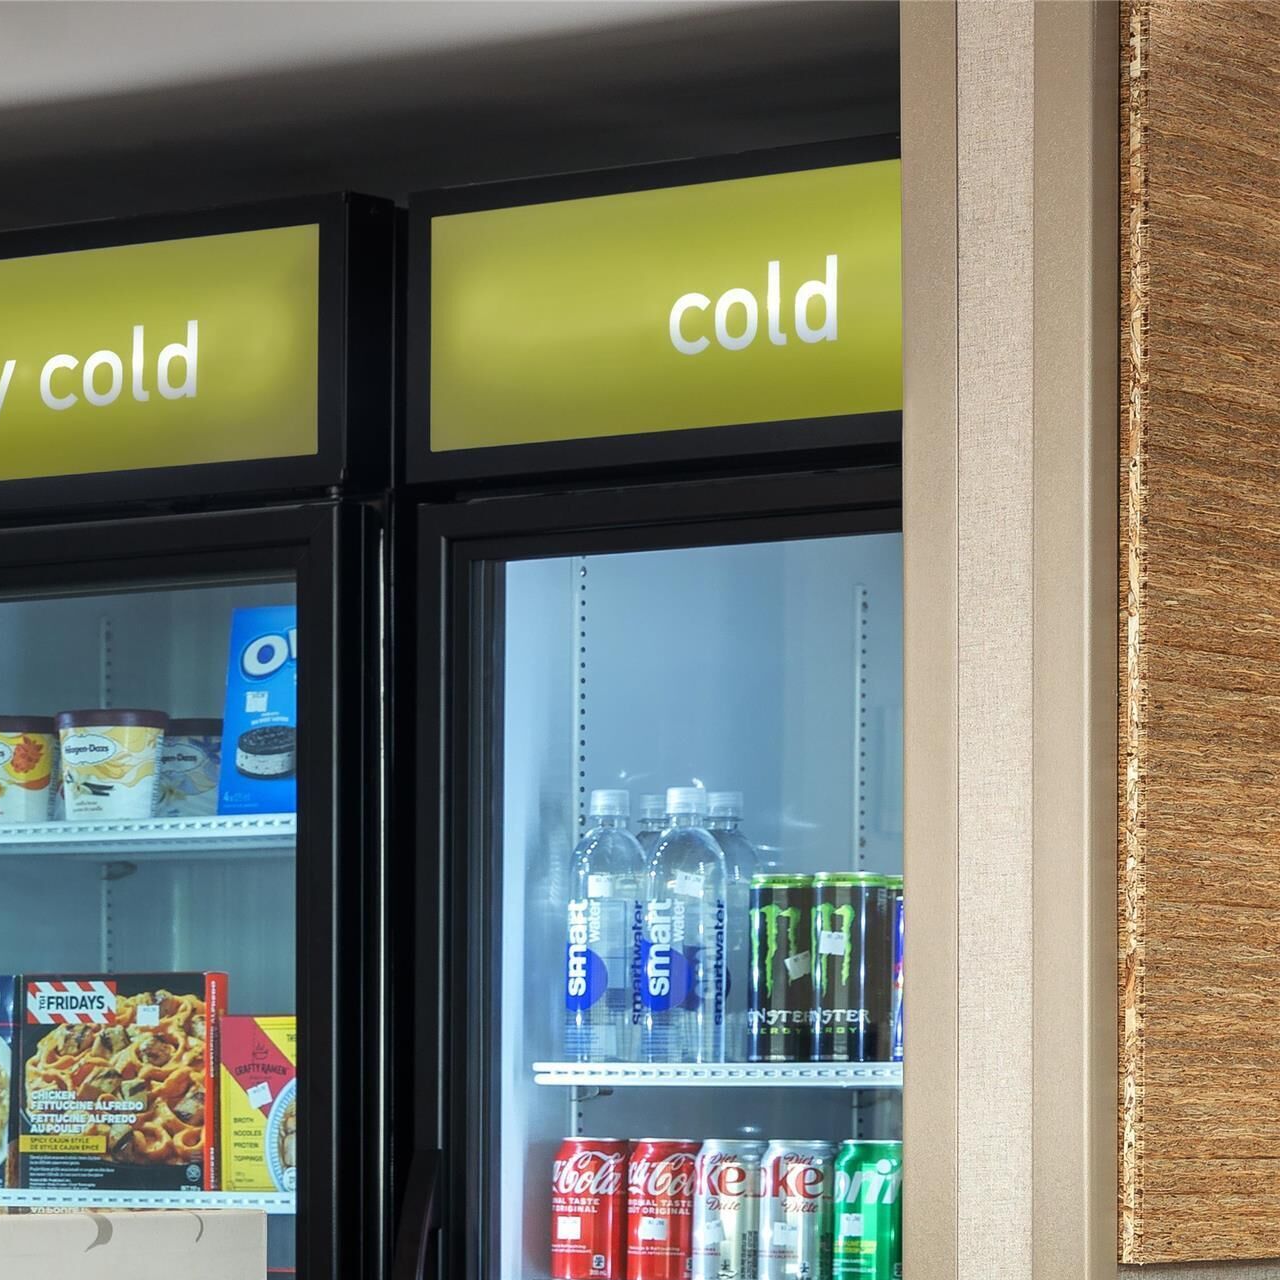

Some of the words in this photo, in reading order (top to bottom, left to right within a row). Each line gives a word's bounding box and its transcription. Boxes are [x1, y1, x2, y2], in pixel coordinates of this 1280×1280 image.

[668, 253, 841, 356] cold
[40, 319, 200, 412] cold
[160, 753, 198, 763] gen-Dazs
[588, 899, 601, 943] water
[672, 898, 685, 943] water
[567, 898, 588, 997] smart
[646, 898, 671, 997] smart
[47, 995, 105, 1010] FRIDAYS
[31, 1091, 76, 1100] CHICKEN
[30, 1101, 94, 1111] FETTUCCINE
[95, 1101, 144, 1111] ALFREDO
[88, 1114, 137, 1124] ALFREDO
[30, 1124, 44, 1134] AU
[44, 1124, 87, 1134] POULET
[711, 1152, 738, 1164] Diet
[784, 1152, 815, 1165] Diet
[699, 1154, 747, 1197] ke
[568, 1197, 600, 1205] TASTE
[661, 1199, 693, 1207] TASTE
[642, 1206, 691, 1215] ORIGINAL
